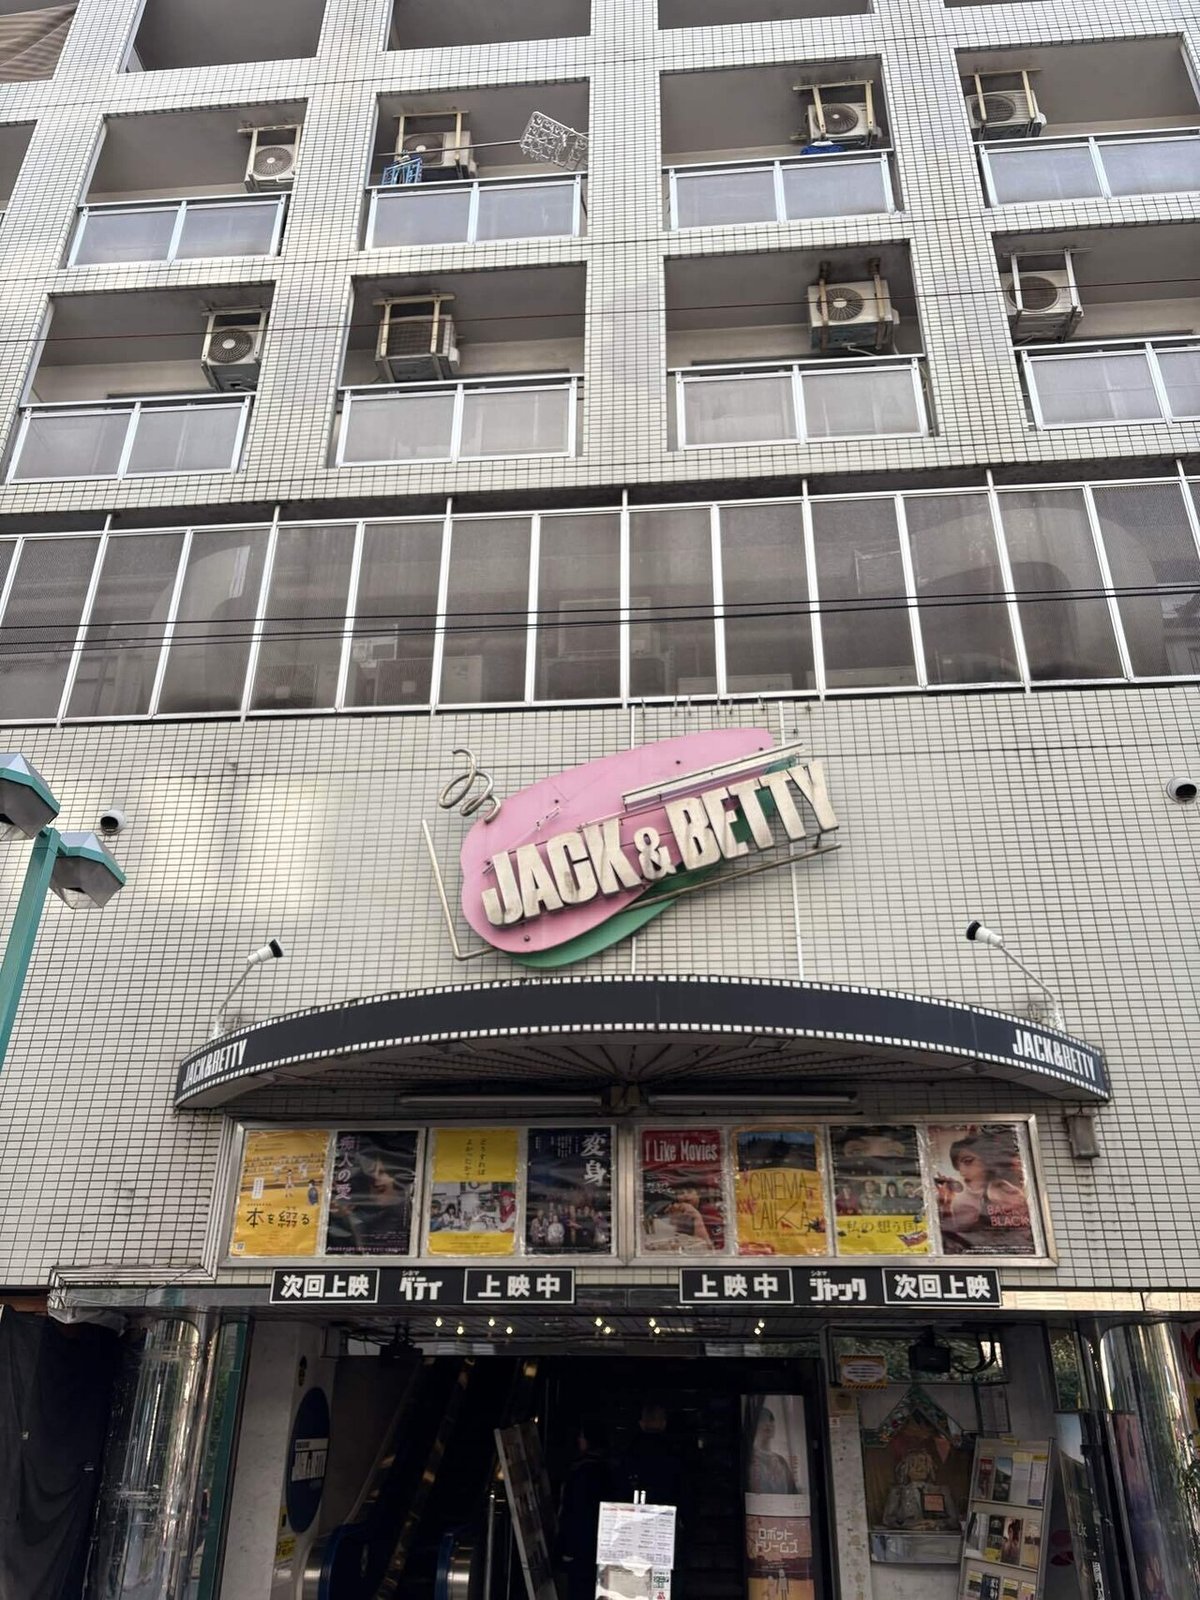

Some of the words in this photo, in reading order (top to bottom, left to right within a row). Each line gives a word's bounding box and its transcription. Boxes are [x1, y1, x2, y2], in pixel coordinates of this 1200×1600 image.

[482, 818, 641, 927] JACK
[635, 827, 677, 881] &
[664, 761, 839, 871] BETTY
[182, 1038, 248, 1090] JACK&BETTY
[1012, 1029, 1096, 1081] JACK&BETTY
[580, 1133, 607, 1186] 変身
[645, 1142, 650, 1162] I
[654, 1140, 676, 1162] Like
[680, 1139, 718, 1161] Movies
[749, 1172, 817, 1200] CINEMA
[246, 1207, 311, 1228] 本を綴る
[280, 1274, 370, 1299] 次回上映
[477, 1274, 561, 1299] 上映中
[694, 1273, 779, 1299] 上映中
[809, 1278, 867, 1301] ジャック
[894, 1274, 991, 1300] 次回上映
[758, 1527, 793, 1540] ロボット
